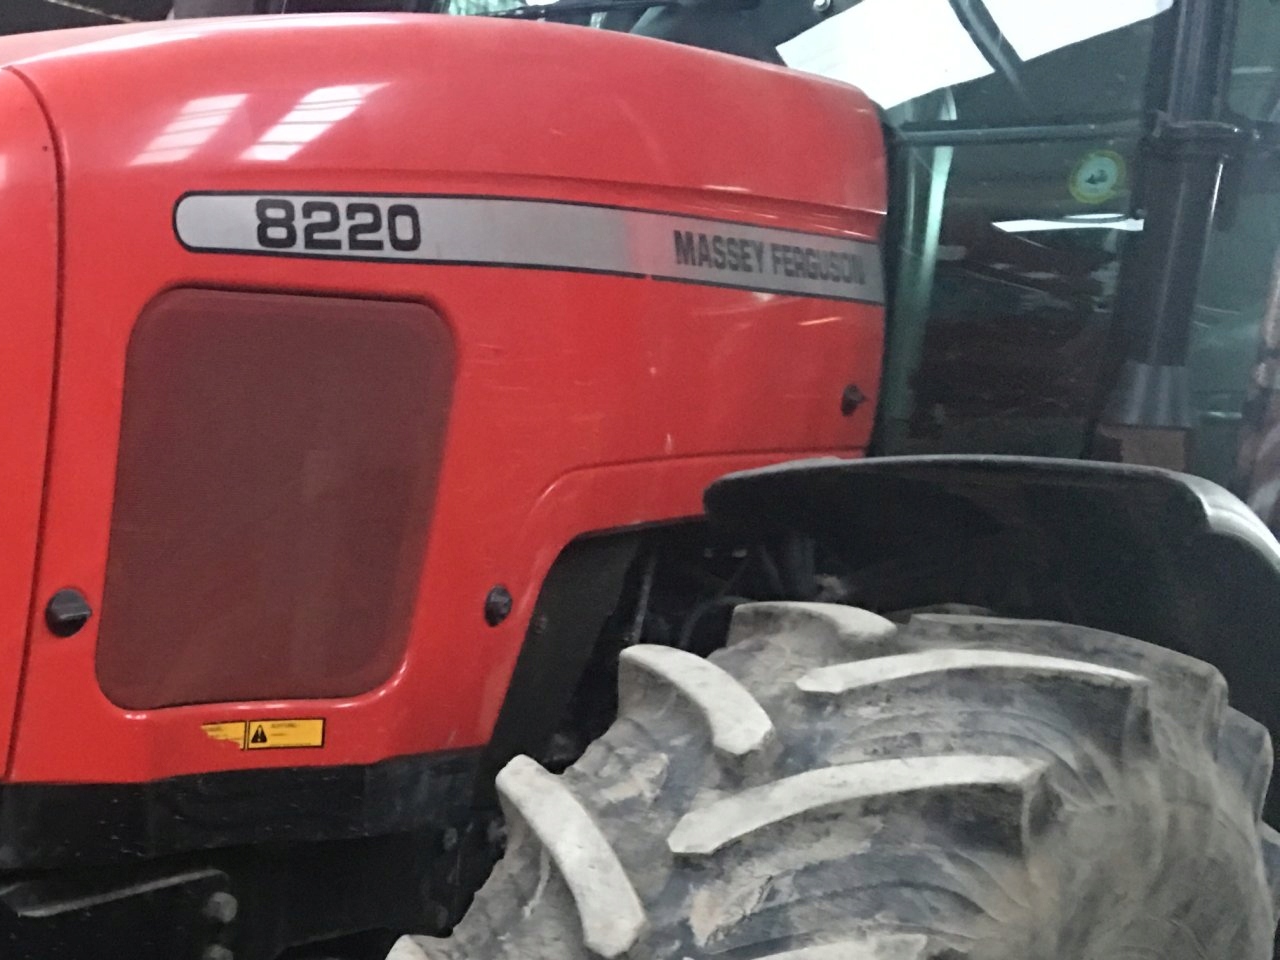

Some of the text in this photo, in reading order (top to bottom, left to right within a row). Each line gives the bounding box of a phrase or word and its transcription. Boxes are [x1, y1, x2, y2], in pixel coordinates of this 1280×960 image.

[256, 198, 421, 252] 8220
[673, 229, 866, 285] MASSEY FERGUSON
